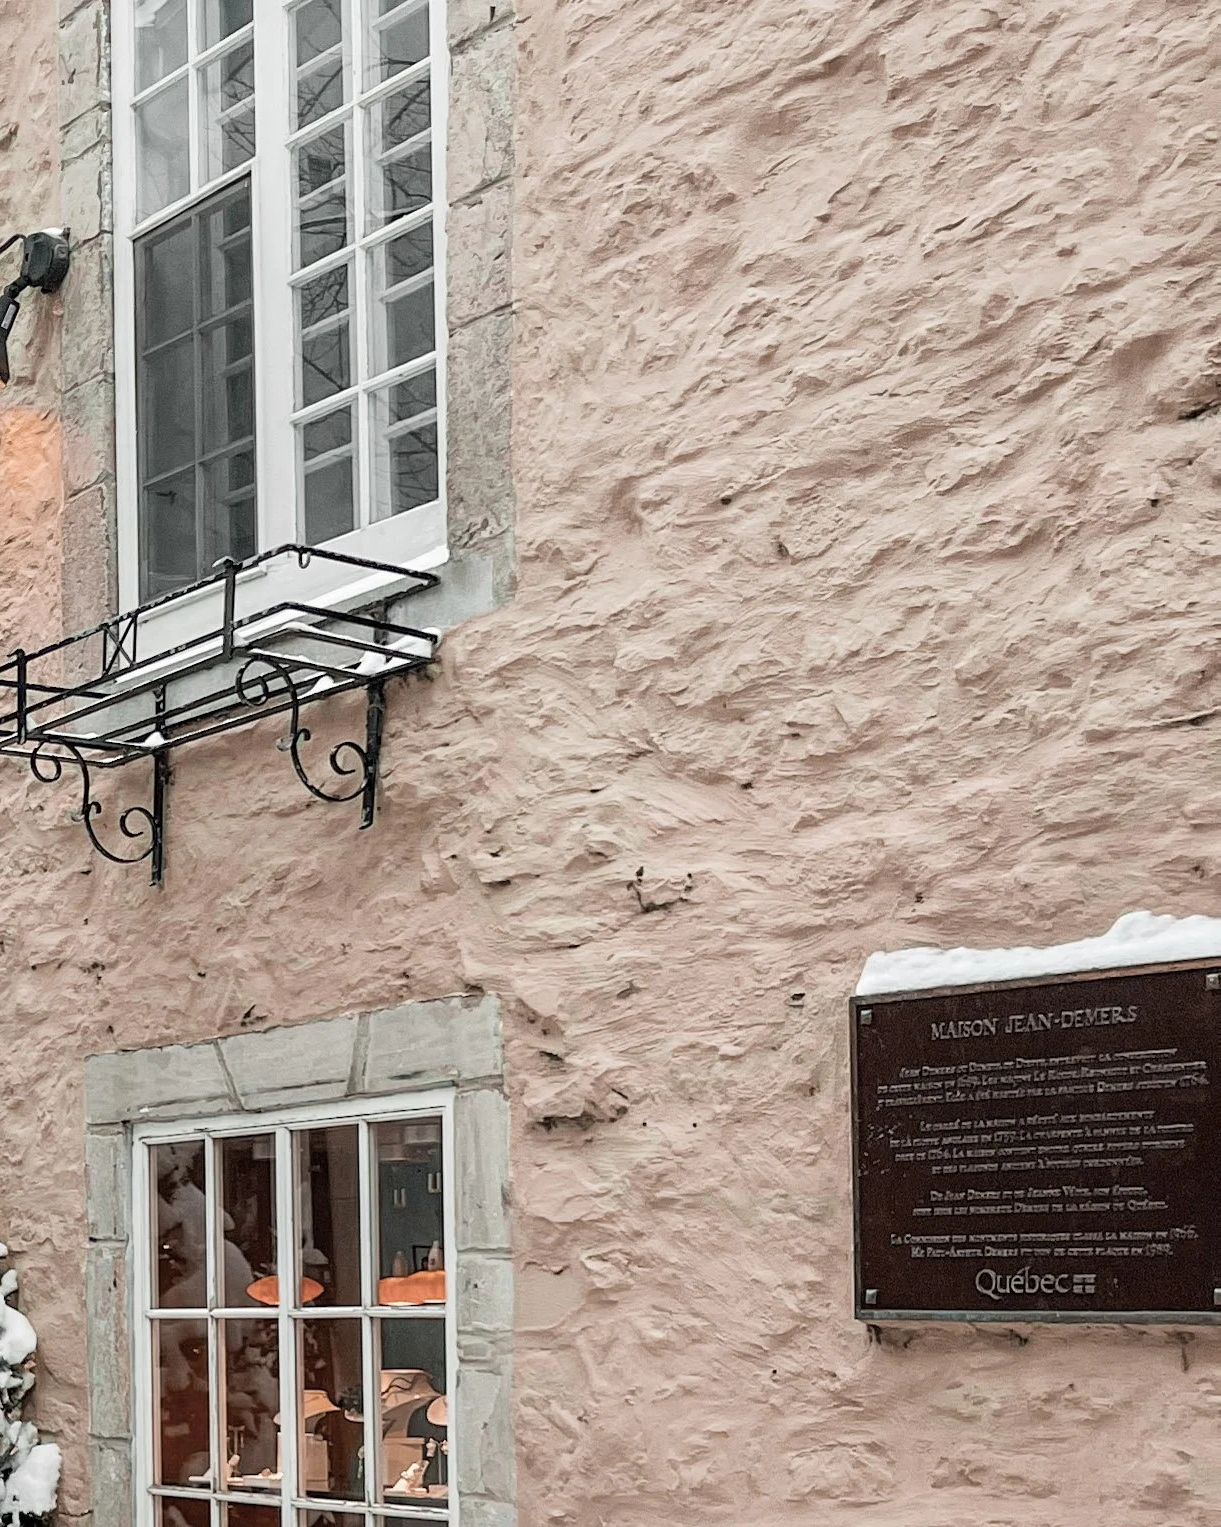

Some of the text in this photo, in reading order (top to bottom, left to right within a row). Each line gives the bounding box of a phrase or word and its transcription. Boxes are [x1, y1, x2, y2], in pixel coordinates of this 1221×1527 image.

[931, 1005, 1139, 1040] MAISON JEAN-DEMERS
[975, 1266, 1071, 1300] Québec
